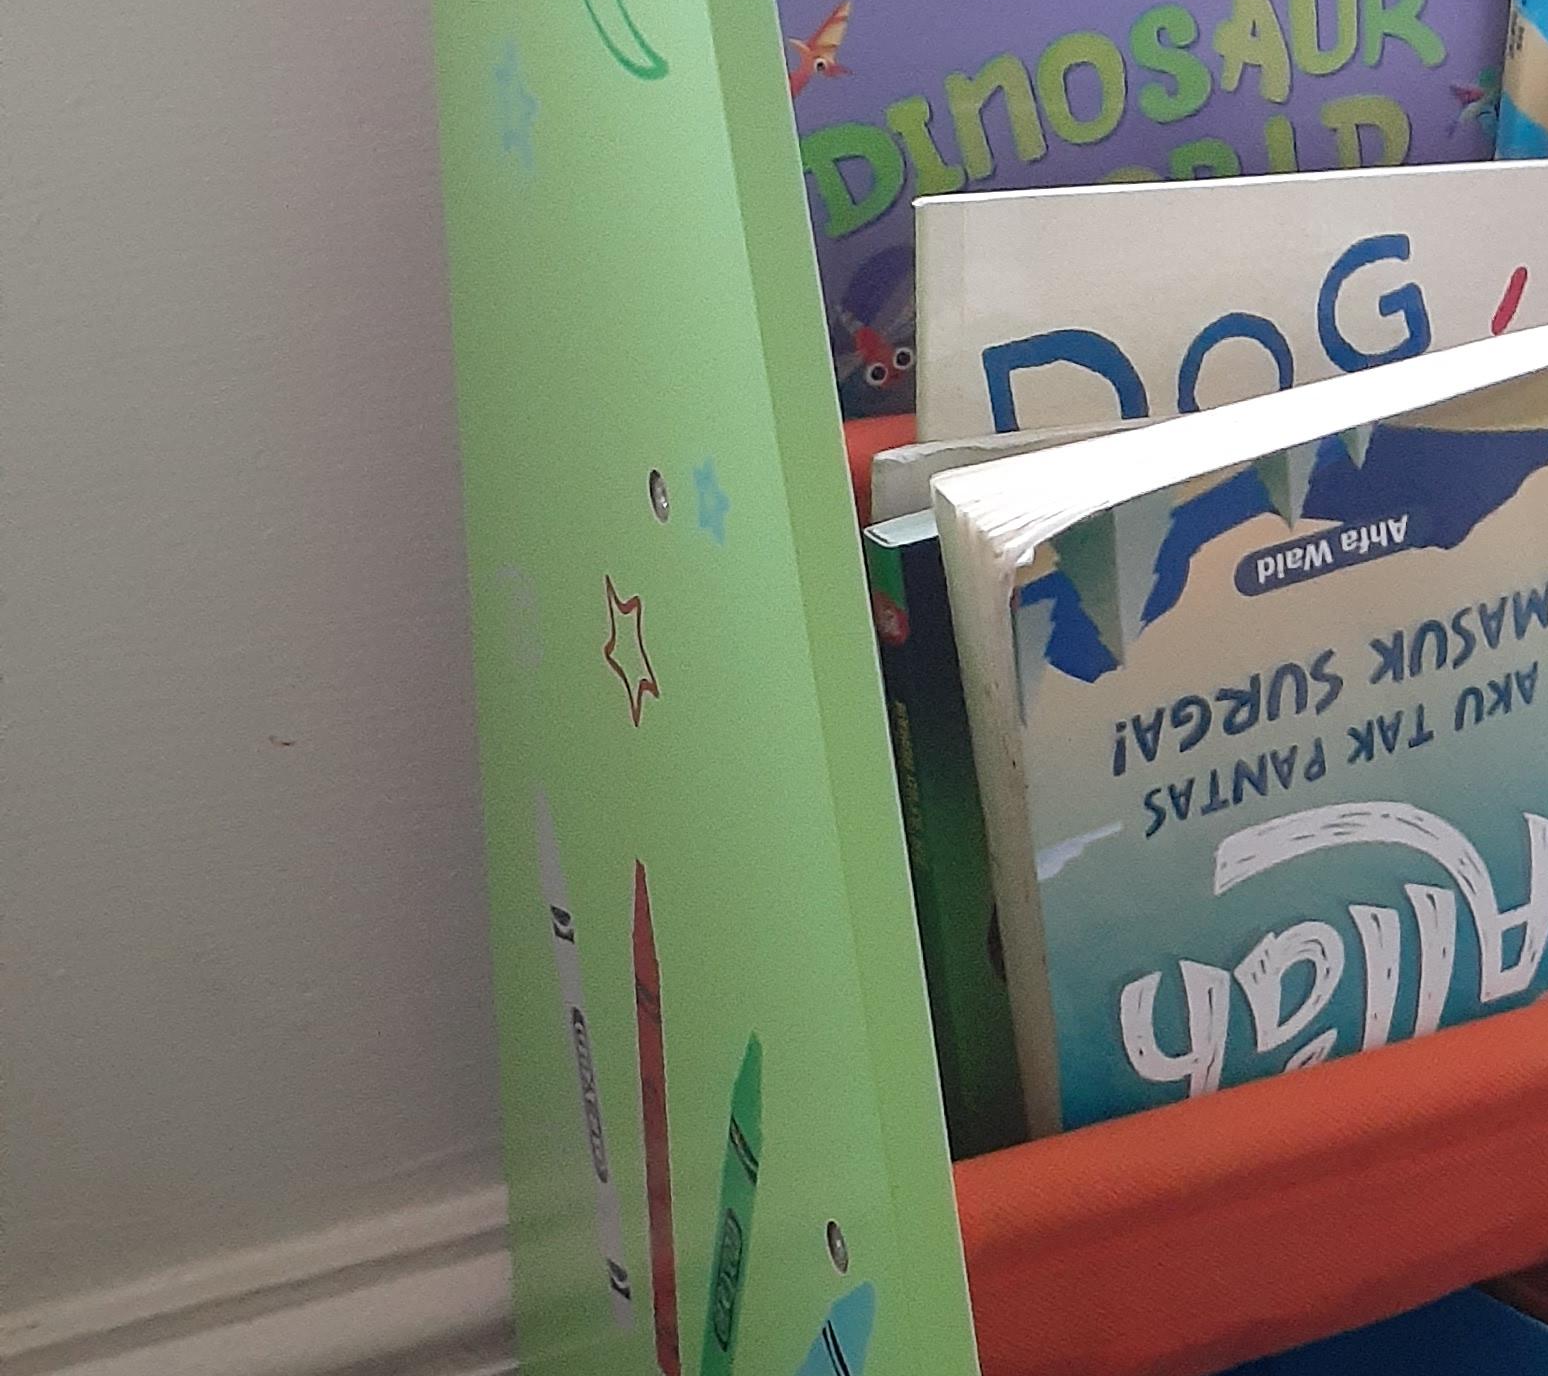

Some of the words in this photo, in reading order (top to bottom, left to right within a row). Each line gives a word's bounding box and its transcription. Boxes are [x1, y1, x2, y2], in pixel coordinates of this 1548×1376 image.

[1340, 513, 1409, 555] Ahfa
[1111, 647, 1345, 777] SURGA!
[1453, 660, 1539, 732] AKU
[1346, 702, 1435, 765] TAK
[1144, 736, 1328, 839] PANTAS
